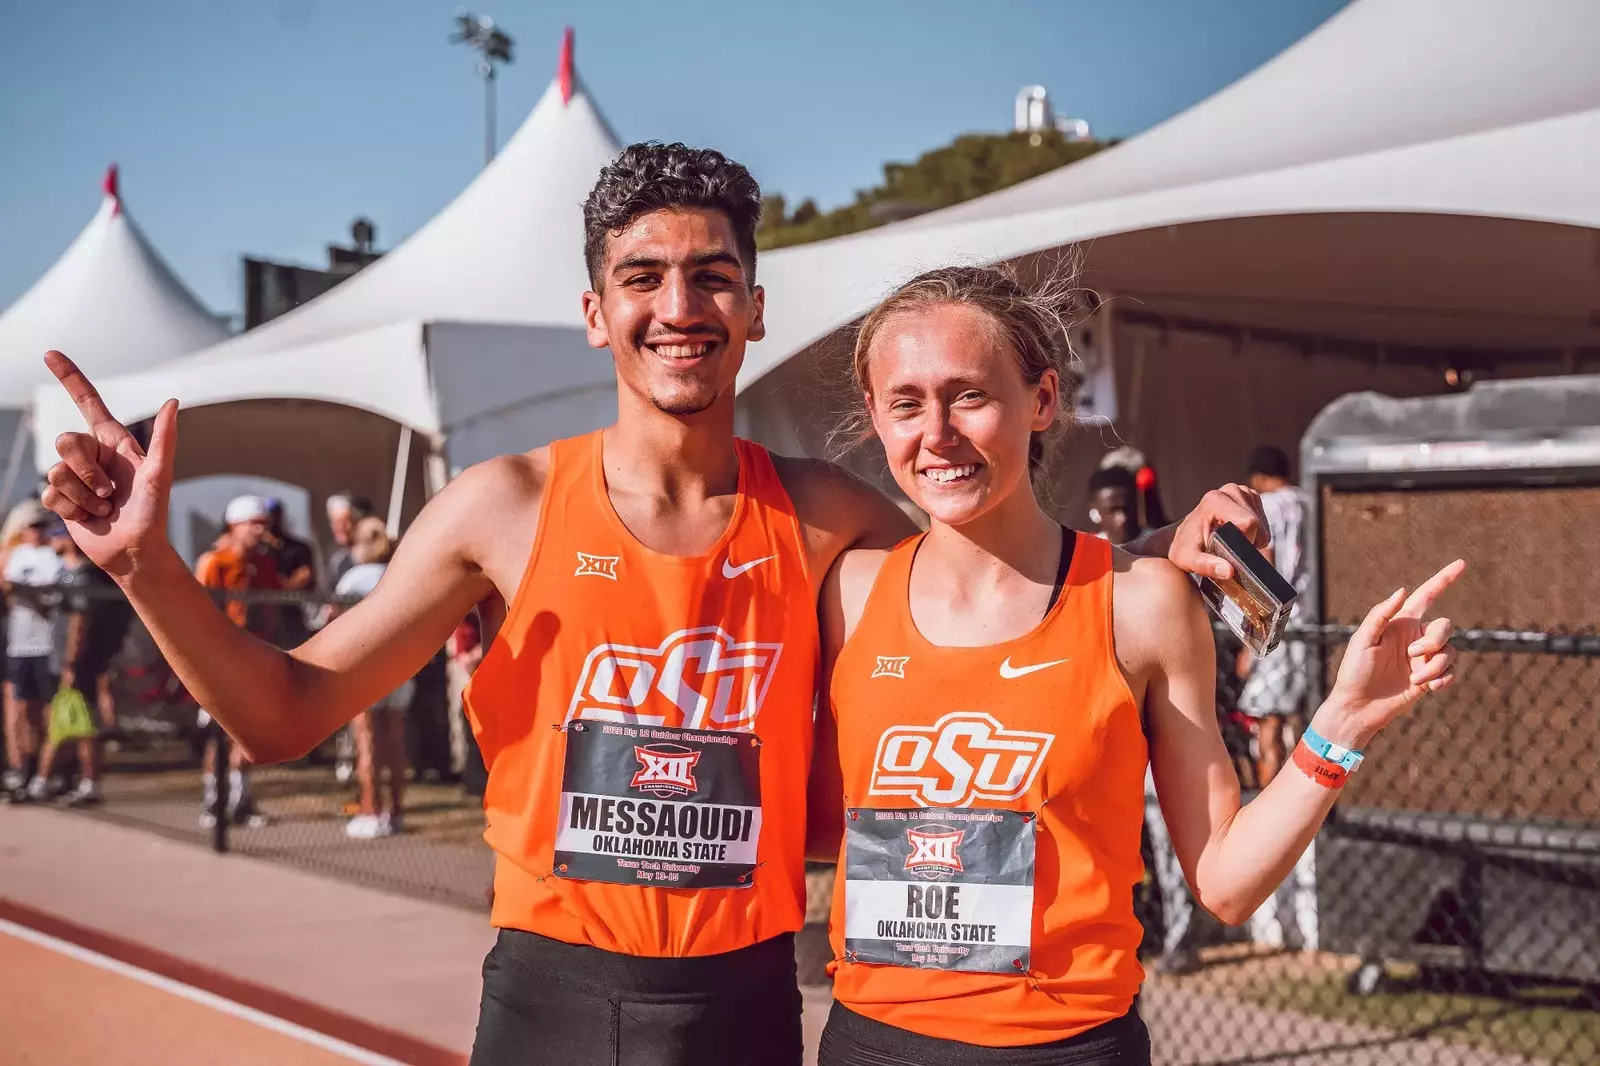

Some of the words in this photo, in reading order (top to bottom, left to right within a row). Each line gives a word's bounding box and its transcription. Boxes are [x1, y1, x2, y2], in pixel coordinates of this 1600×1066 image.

[602, 725, 623, 735] 2022
[624, 727, 637, 738] Big
[639, 729, 650, 738] 12
[651, 730, 681, 741] Outdoor
[682, 733, 739, 745] Championships
[637, 752, 695, 784] XII
[874, 719, 1042, 805] OSU
[643, 784, 685, 793] CHAMPIONSHIP
[569, 796, 754, 842] MESSAOUDI
[875, 812, 893, 821] 2022
[894, 812, 907, 822] Big
[909, 812, 918, 820] 12
[919, 812, 945, 821] Outdoor
[945, 813, 1003, 823] Championships
[592, 835, 678, 859] OKLAHOMA
[682, 842, 727, 861] STATE
[909, 836, 960, 865] XII
[617, 859, 639, 868] Texas
[641, 861, 660, 870] Tech
[662, 862, 701, 874] University
[636, 871, 653, 881] May
[655, 872, 679, 881] 13-15
[906, 884, 960, 920] ROE
[877, 920, 947, 940] OKLAHOMA
[951, 923, 996, 942] STATE
